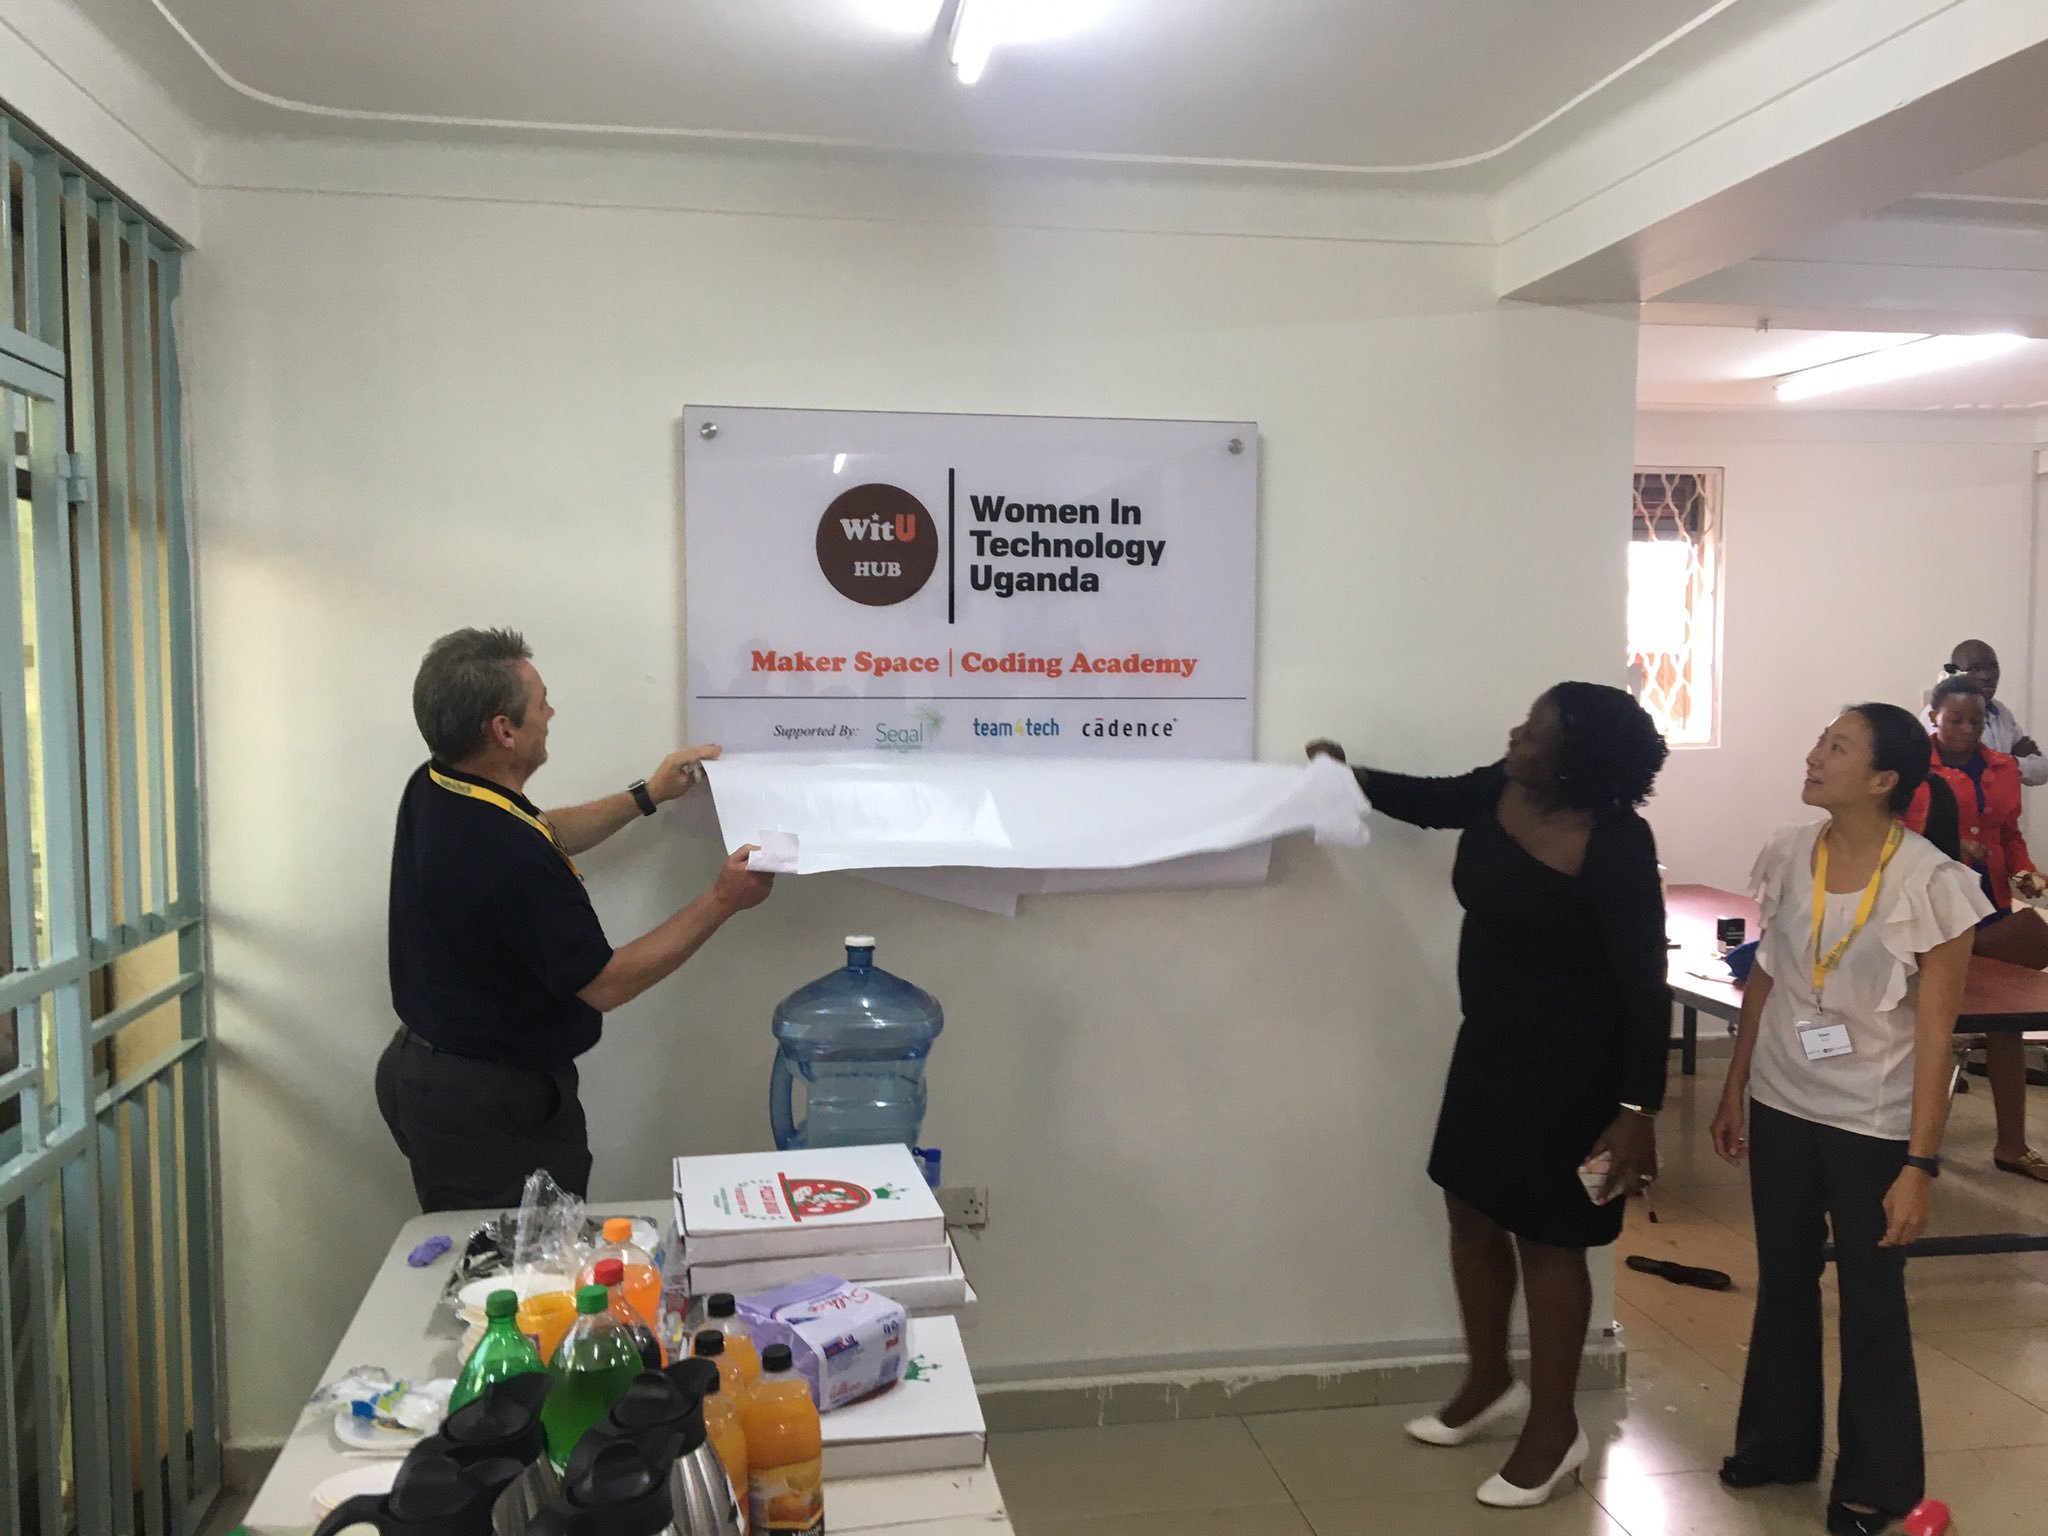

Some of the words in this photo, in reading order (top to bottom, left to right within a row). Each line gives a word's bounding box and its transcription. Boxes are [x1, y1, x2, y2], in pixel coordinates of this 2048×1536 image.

[970, 494, 1099, 524] Women
[1111, 498, 1141, 526] In
[840, 512, 916, 543] WitU
[970, 530, 1166, 566] Technology
[853, 561, 902, 577] HUB
[970, 565, 1100, 598] Uganda
[751, 649, 847, 673] Maker
[854, 651, 940, 677] Space
[961, 652, 1063, 678] Coding
[1069, 652, 1199, 678] Academy
[773, 724, 837, 740] Supported
[875, 722, 924, 748] Segal
[973, 717, 1060, 737] team4tech
